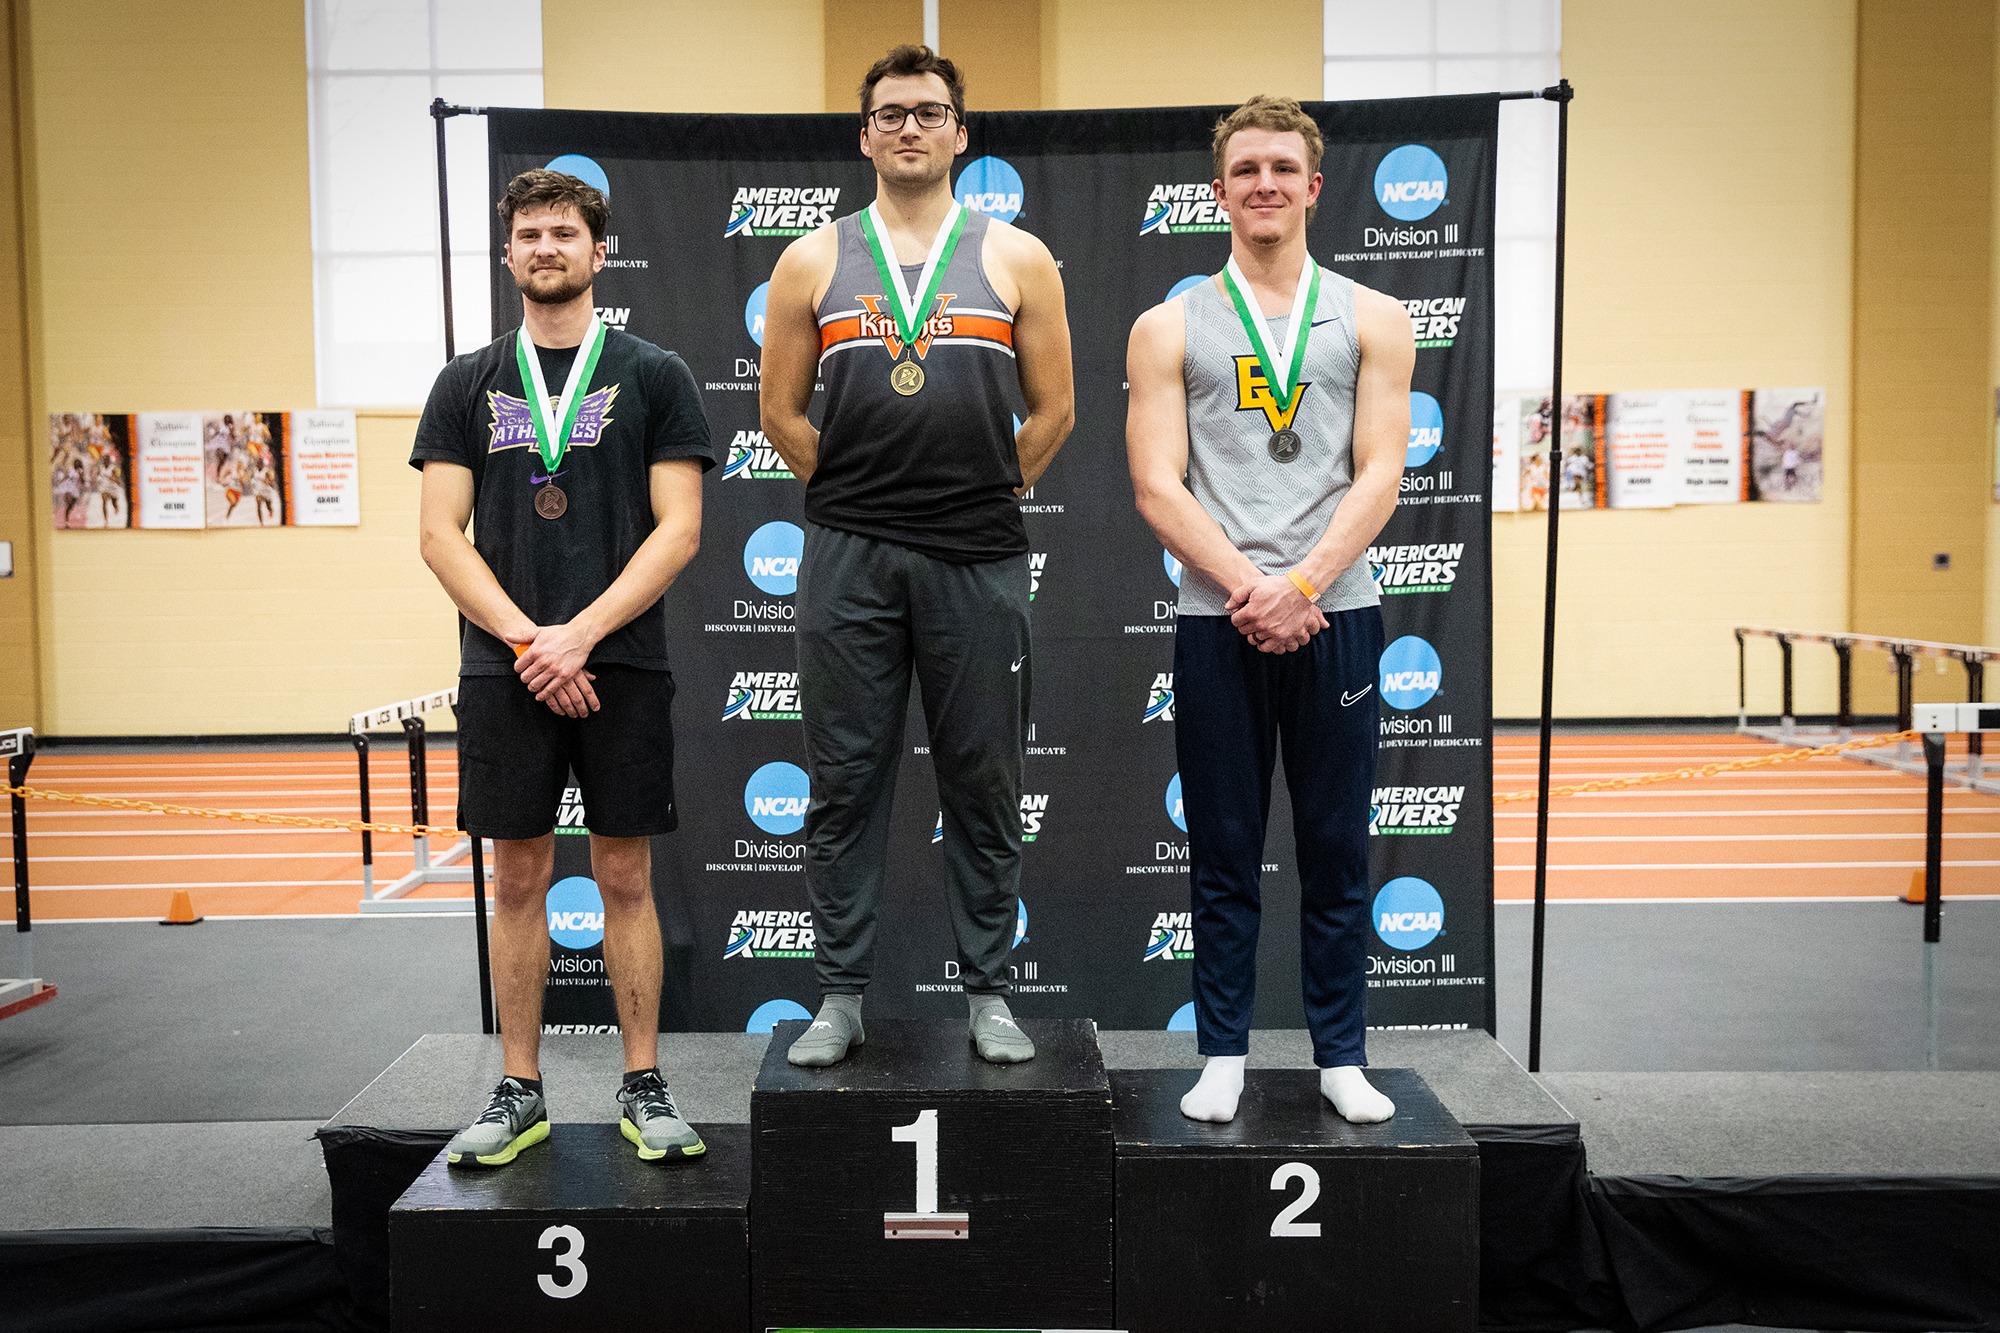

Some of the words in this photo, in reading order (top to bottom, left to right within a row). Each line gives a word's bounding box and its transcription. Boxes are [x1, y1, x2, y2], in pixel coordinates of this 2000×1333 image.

[732, 187, 841, 204] AMERICAN
[1148, 184, 1216, 201] AMER
[1382, 180, 1444, 203] NCAA
[963, 193, 1021, 213] NCAA
[724, 204, 836, 238] RIVERS
[1140, 201, 1231, 236] RIVER
[1364, 226, 1438, 247] Division
[1444, 224, 1458, 243] III
[1334, 253, 1384, 262] DISCOVER
[1388, 251, 1432, 260] DEVELOP
[1439, 248, 1485, 257] DEDICATE
[1399, 297, 1467, 316] RICAN
[705, 382, 753, 391] DISCOVER
[1408, 427, 1441, 448] CAA
[1400, 472, 1434, 492] sion
[1439, 471, 1452, 490] III
[1396, 497, 1430, 506] EVELOP
[1434, 495, 1482, 504] DEDICATE
[1366, 543, 1464, 562] AMERICAN
[751, 557, 799, 577] NCA
[1387, 587, 1448, 595] CONFERENCE
[734, 600, 797, 620] Divisio
[704, 624, 752, 633] DISCOVER
[758, 625, 797, 633] DEVELO
[1124, 625, 1174, 634] DISCOVER
[730, 672, 800, 689] AMERI
[1383, 671, 1439, 693] NCAA
[722, 688, 802, 722] RIVE
[756, 712, 803, 720] CONFERE
[1380, 715, 1433, 735] ivision
[1438, 714, 1452, 734] III
[1026, 747, 1067, 755] EDICATE
[1386, 739, 1428, 748] DEVELOP
[1433, 738, 1482, 747] DEDICATE
[735, 840, 807, 859] Division
[1155, 842, 1190, 861] Divi
[706, 863, 753, 872] DISCOVER
[758, 863, 803, 872] DEVELOP
[1126, 865, 1175, 874] DISCOVER
[731, 910, 813, 928] AMERIC
[1379, 912, 1442, 932] NCAA
[723, 926, 817, 960] RIVER
[550, 955, 603, 973] vision
[1025, 962, 1038, 979] III
[1442, 954, 1455, 973] III
[555, 978, 600, 986] DEVELOP
[915, 984, 964, 993] DISCOVER
[1019, 984, 1068, 993] DEDICATE
[1386, 979, 1431, 988] DEVELOP
[1436, 977, 1486, 986] DEDICATE
[891, 1109, 938, 1214] 1
[1270, 1162, 1322, 1237] 2
[537, 1224, 588, 1299] 3
